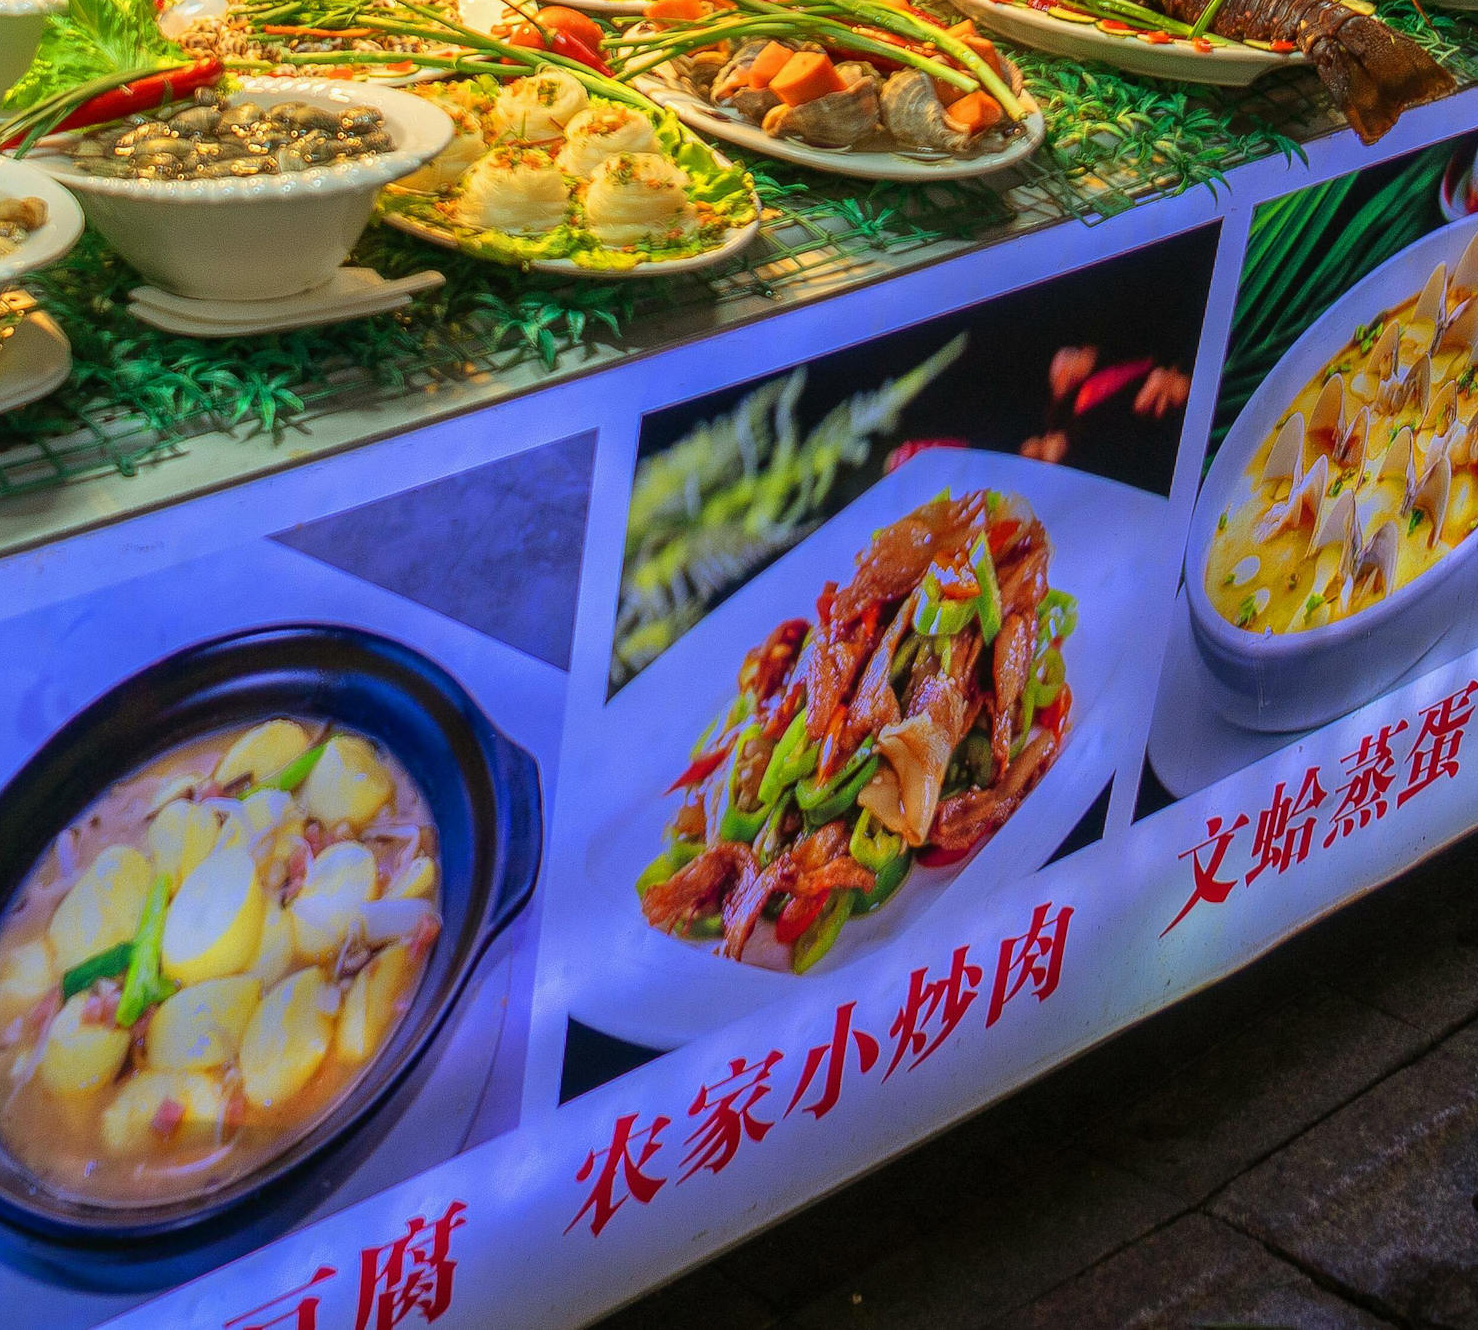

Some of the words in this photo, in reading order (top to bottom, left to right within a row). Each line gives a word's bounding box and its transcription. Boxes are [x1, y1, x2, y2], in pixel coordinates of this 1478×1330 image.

[562, 901, 1076, 1237] 农家小炒肉
